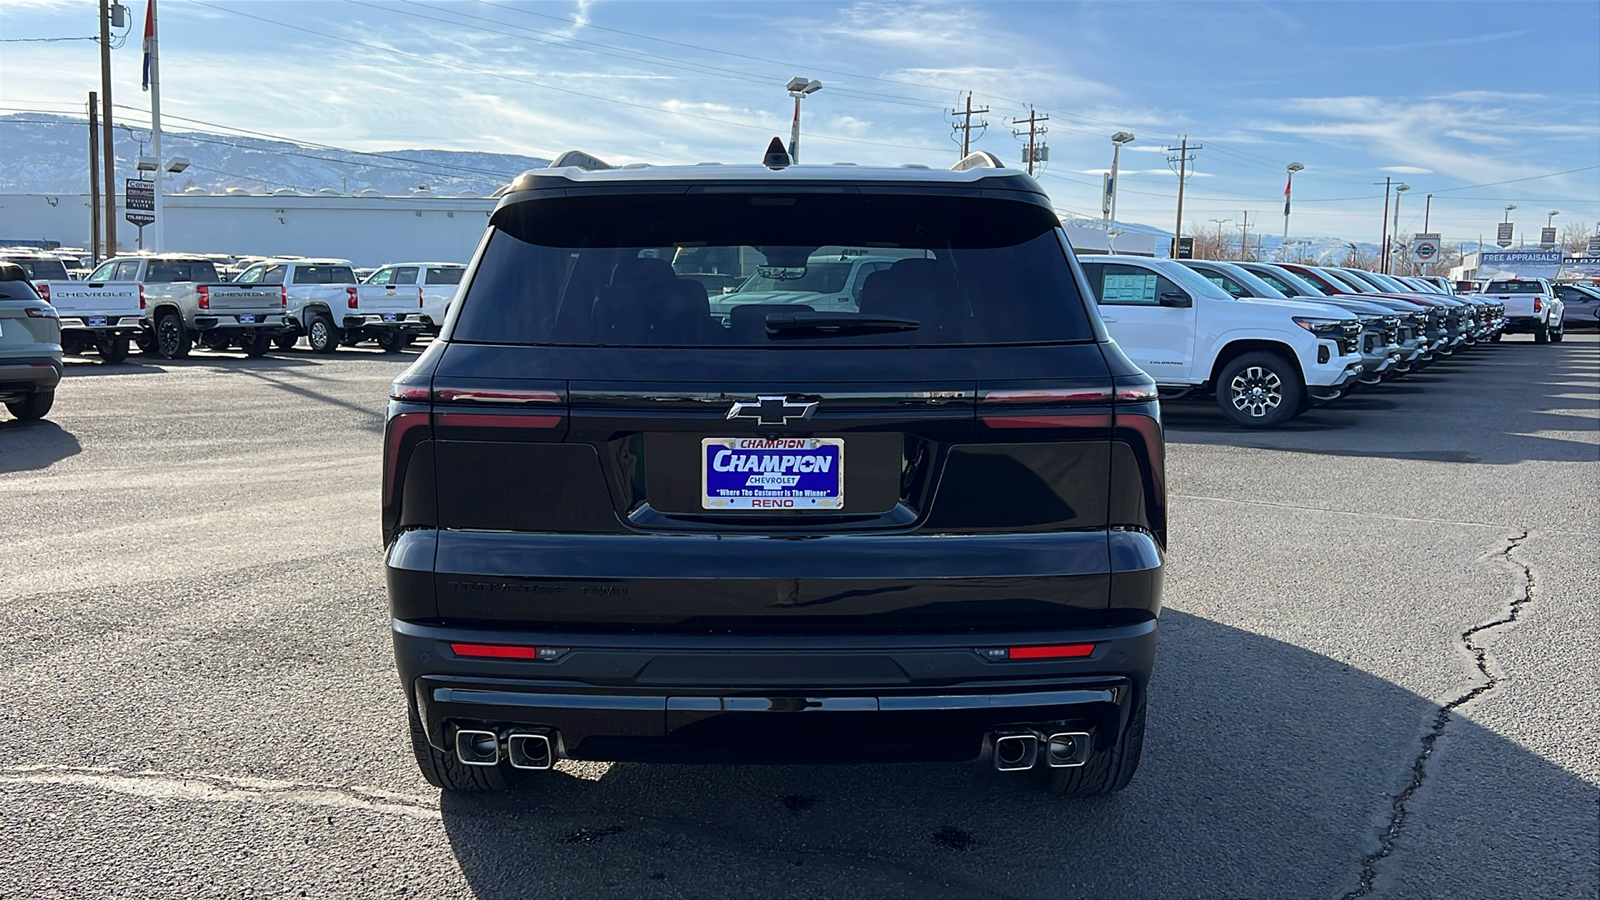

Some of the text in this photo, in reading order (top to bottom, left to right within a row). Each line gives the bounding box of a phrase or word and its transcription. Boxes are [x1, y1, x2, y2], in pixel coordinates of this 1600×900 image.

[1484, 253, 1560, 262] FREE APPRAISALS!
[740, 439, 806, 449] CHAMPION
[712, 450, 833, 473] CHAMPION
[742, 489, 753, 497] The
[754, 489, 784, 497] Customer
[785, 489, 791, 497] Is
[792, 489, 803, 497] The
[752, 499, 794, 507] RENO
[448, 580, 568, 594] TRAVERSE
